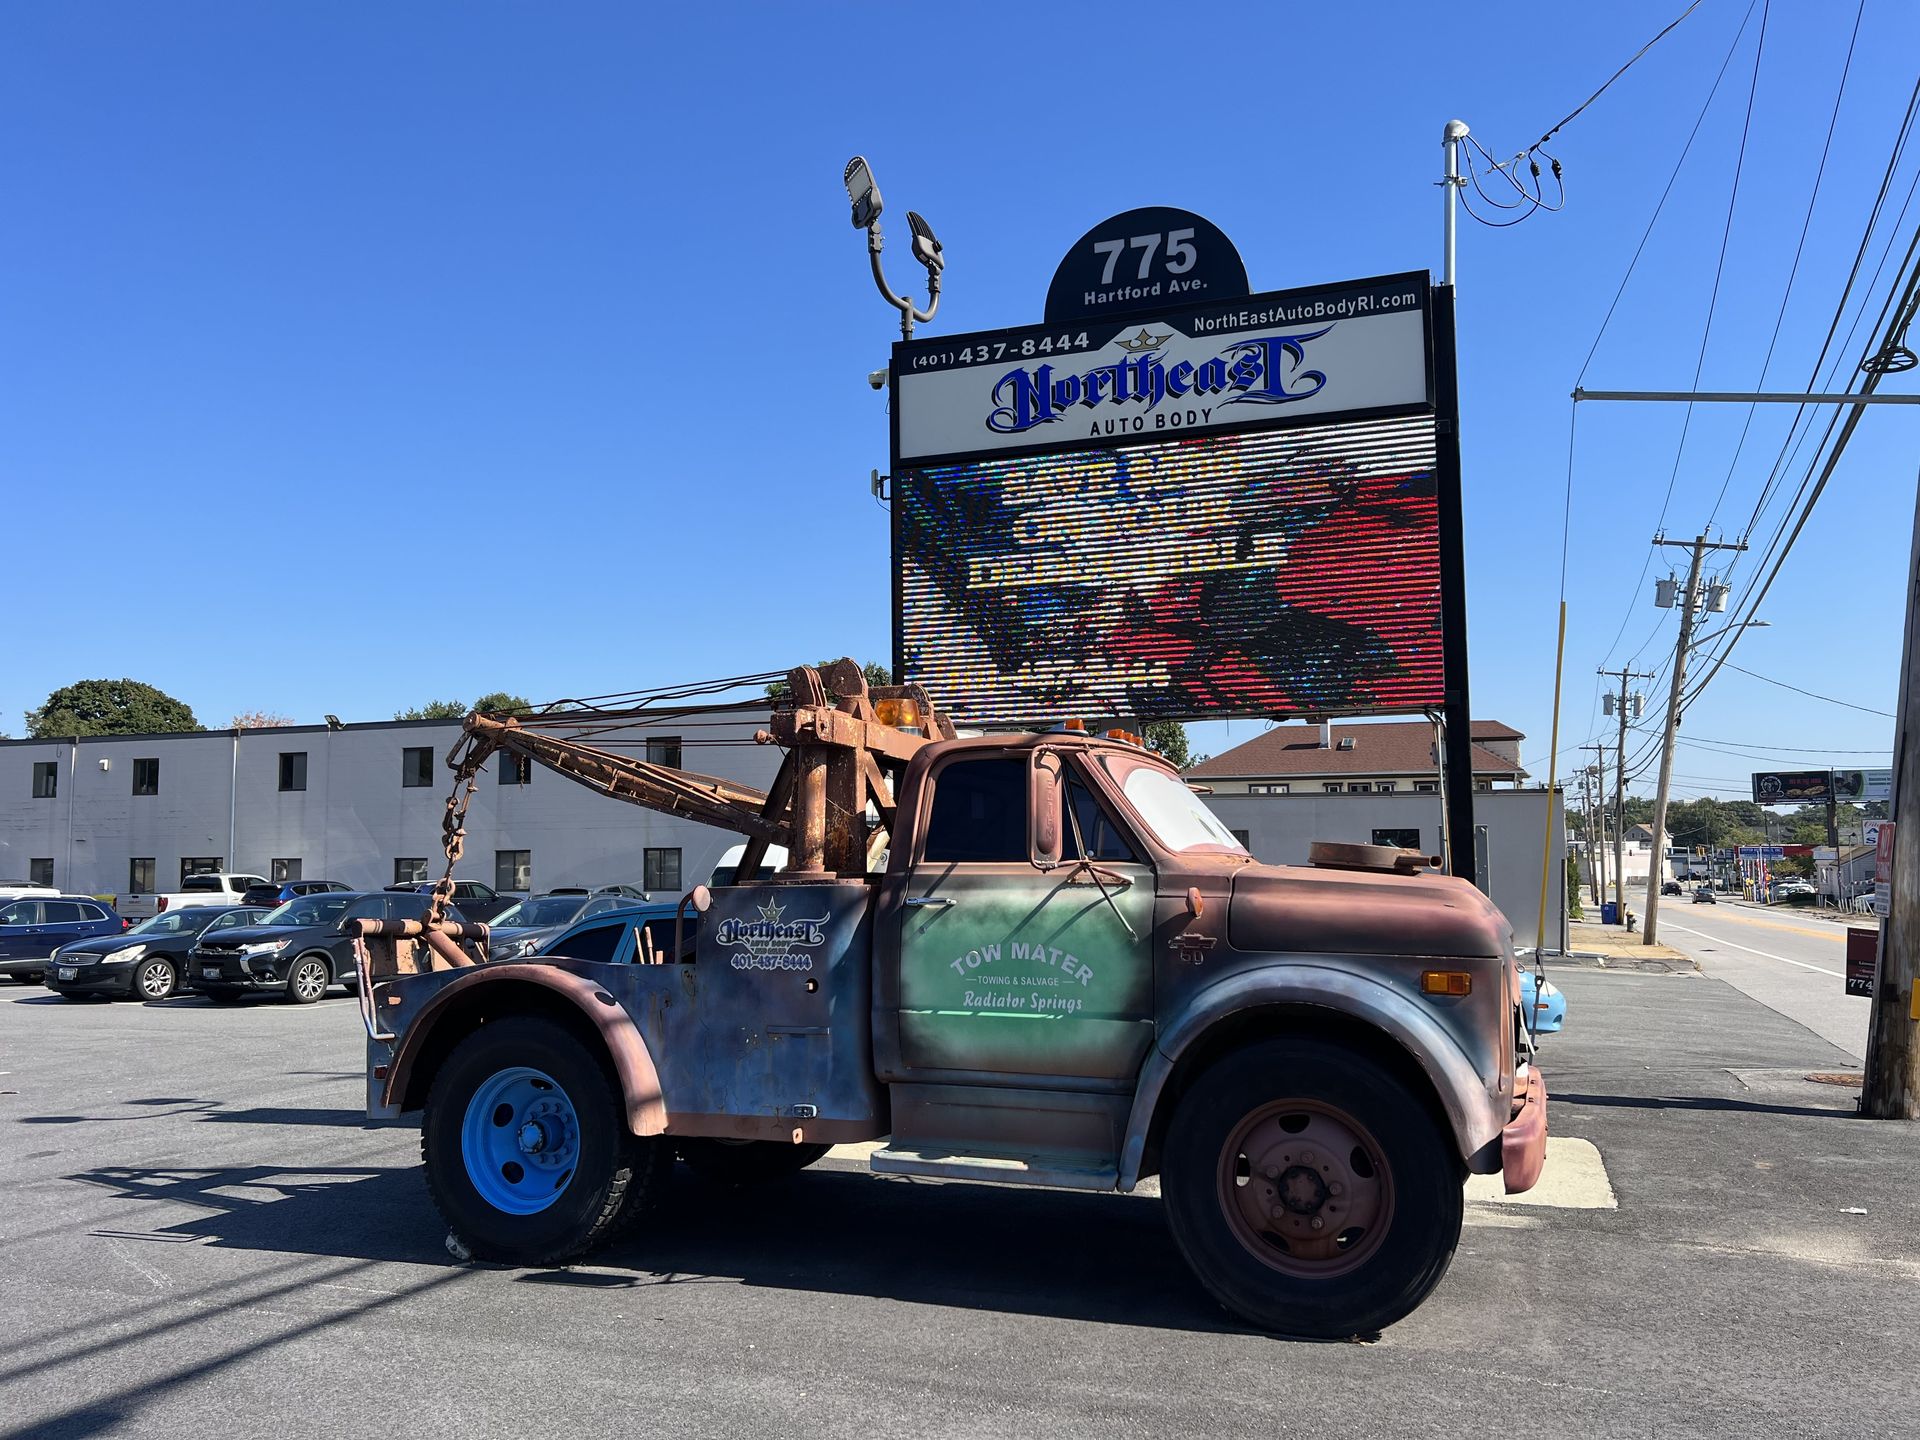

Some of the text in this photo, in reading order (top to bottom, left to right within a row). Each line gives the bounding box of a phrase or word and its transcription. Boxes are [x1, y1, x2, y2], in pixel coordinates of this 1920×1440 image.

[1093, 227, 1197, 284] 775
[1084, 279, 1207, 305] Hartford Ave.
[1194, 292, 1416, 332] NorthEastAutoBodyRI.com
[912, 332, 1090, 369] (401) 437-8444
[1090, 407, 1213, 437] AUTO BODY
[731, 954, 812, 971] 401-437-8444
[950, 942, 1094, 987] TOW MATER
[977, 975, 1059, 986] TOWING & SALVAGE
[963, 990, 1082, 1014] Radiator Springs
